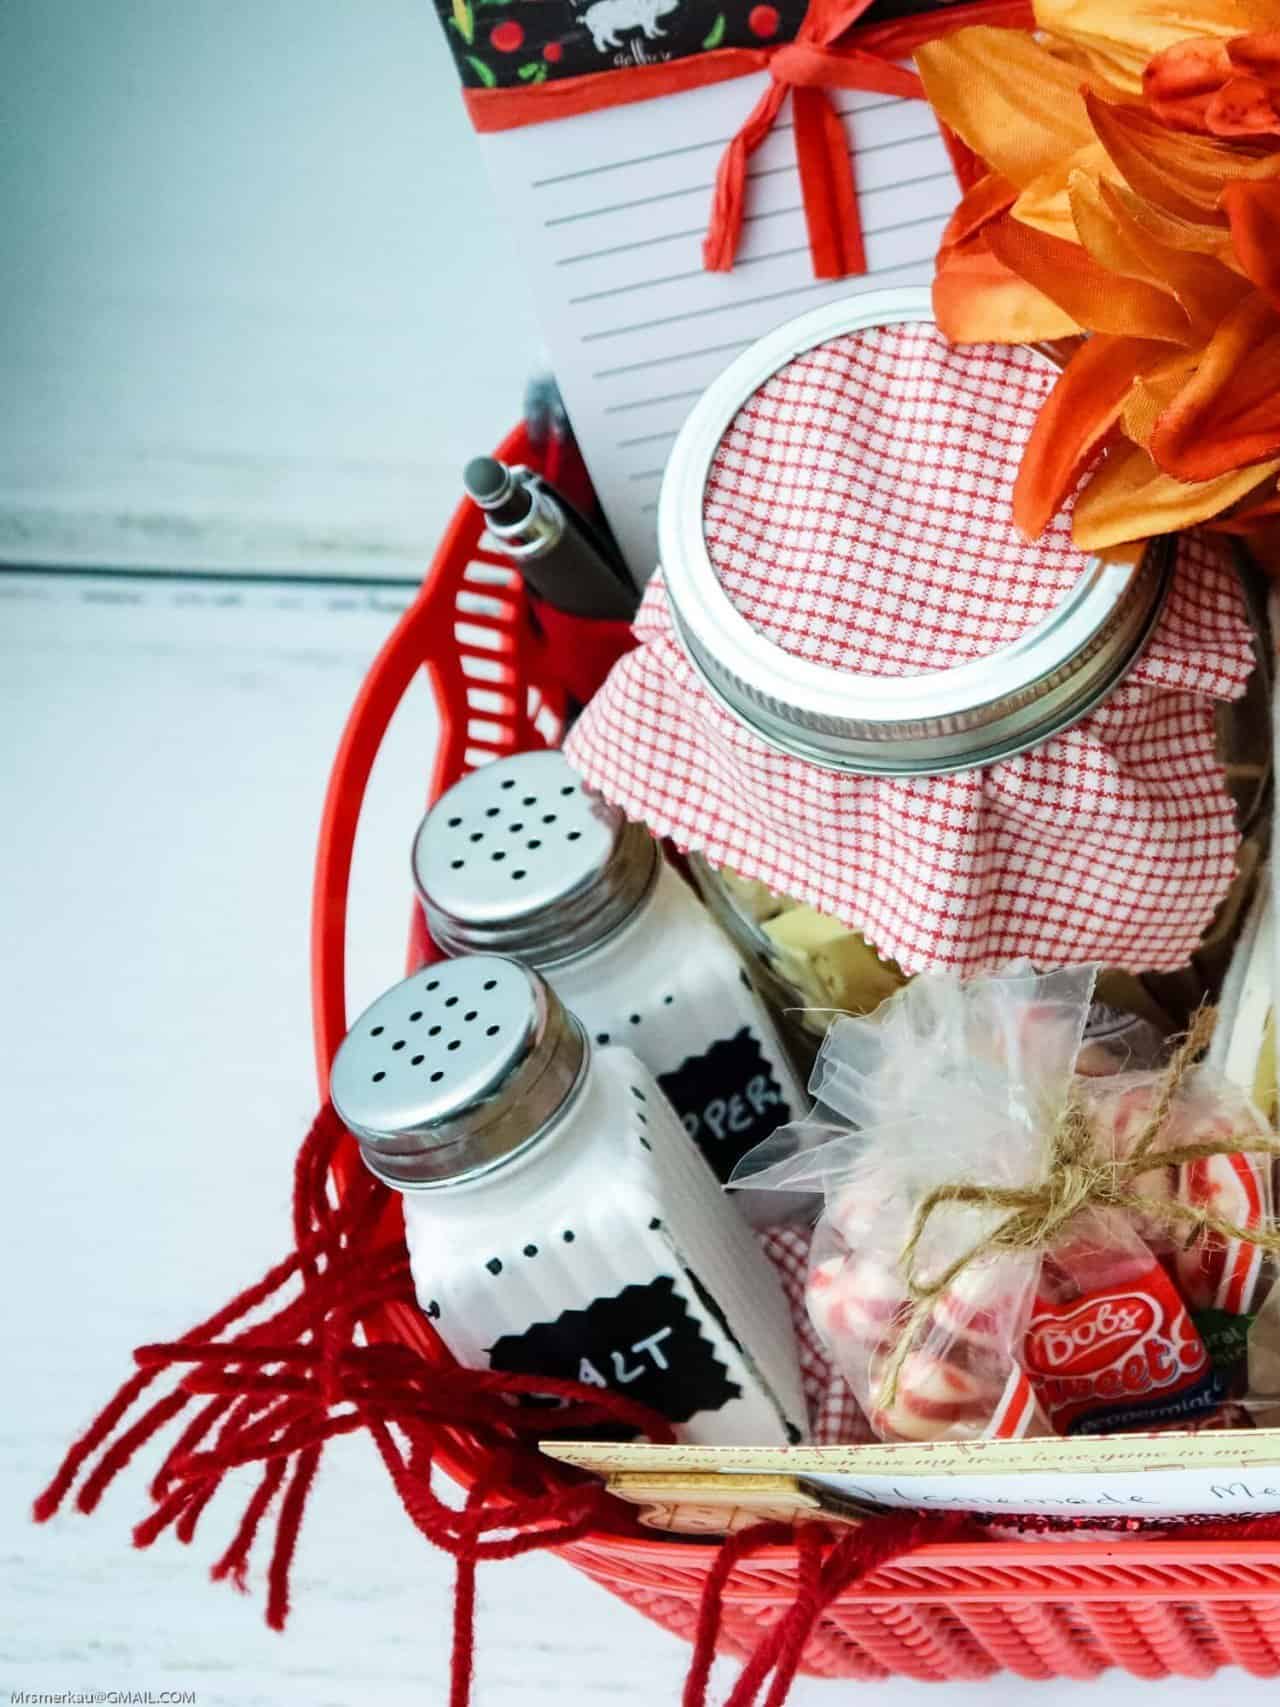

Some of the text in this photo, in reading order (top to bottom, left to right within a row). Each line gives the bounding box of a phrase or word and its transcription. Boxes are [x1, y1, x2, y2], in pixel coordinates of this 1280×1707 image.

[682, 1074, 782, 1139] PPER
[560, 1326, 673, 1397] ALT
[1042, 1303, 1145, 1368] Bobs
